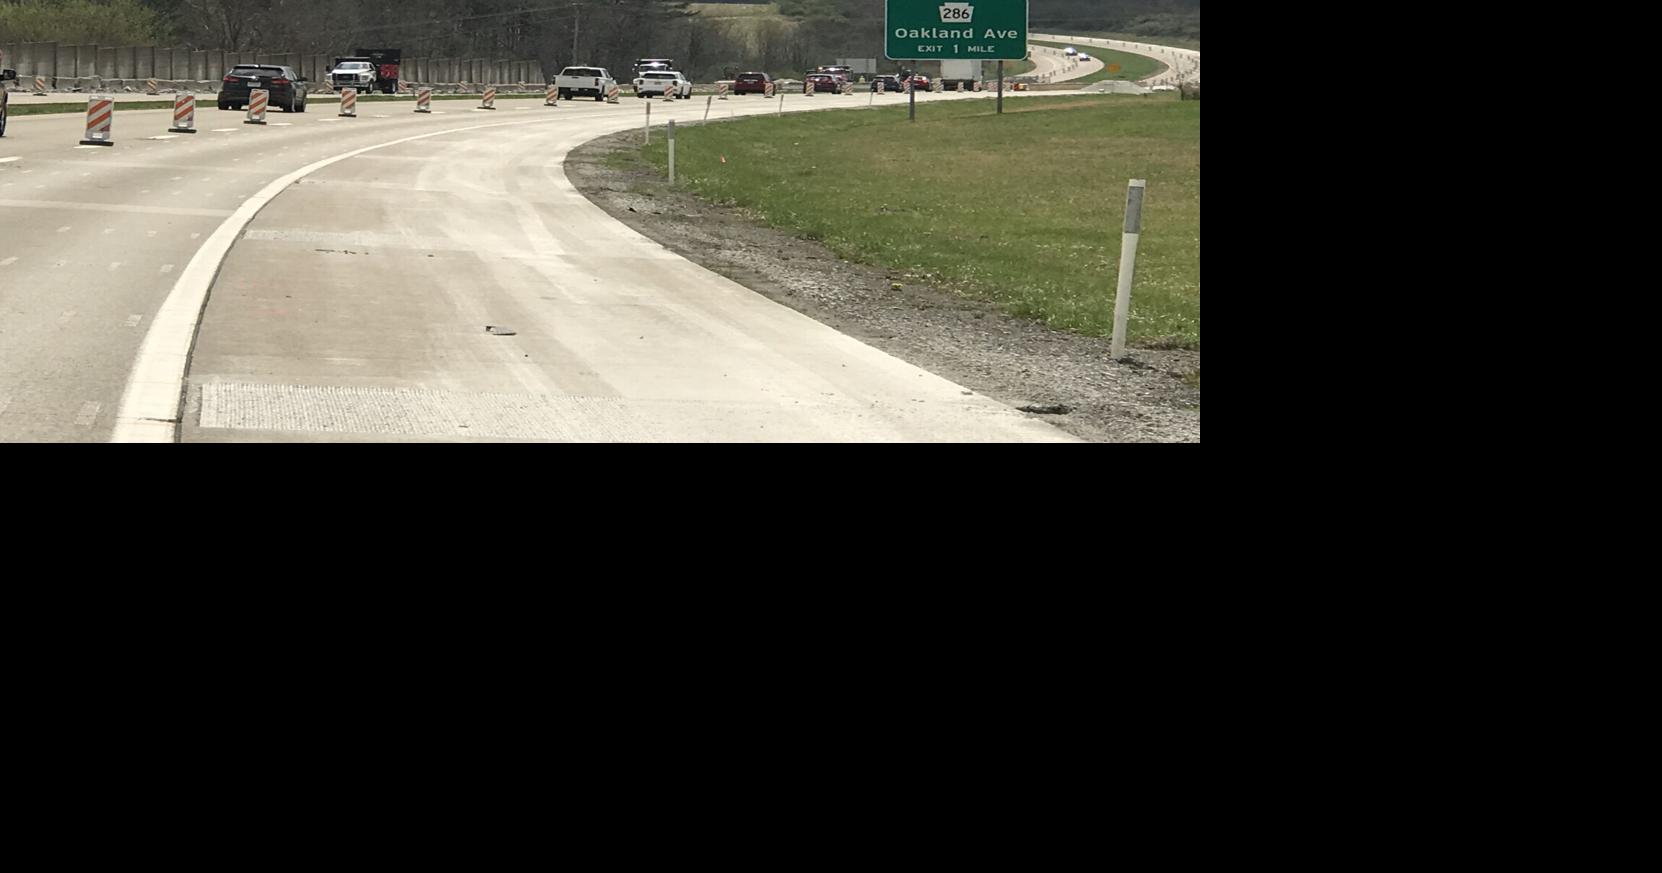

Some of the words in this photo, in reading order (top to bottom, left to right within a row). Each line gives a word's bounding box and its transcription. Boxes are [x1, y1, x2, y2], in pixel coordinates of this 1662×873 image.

[943, 8, 970, 19] 286
[895, 27, 974, 39] Oakland
[984, 28, 1018, 39] Ave
[953, 44, 959, 54] 1
[967, 45, 995, 53] MILE
